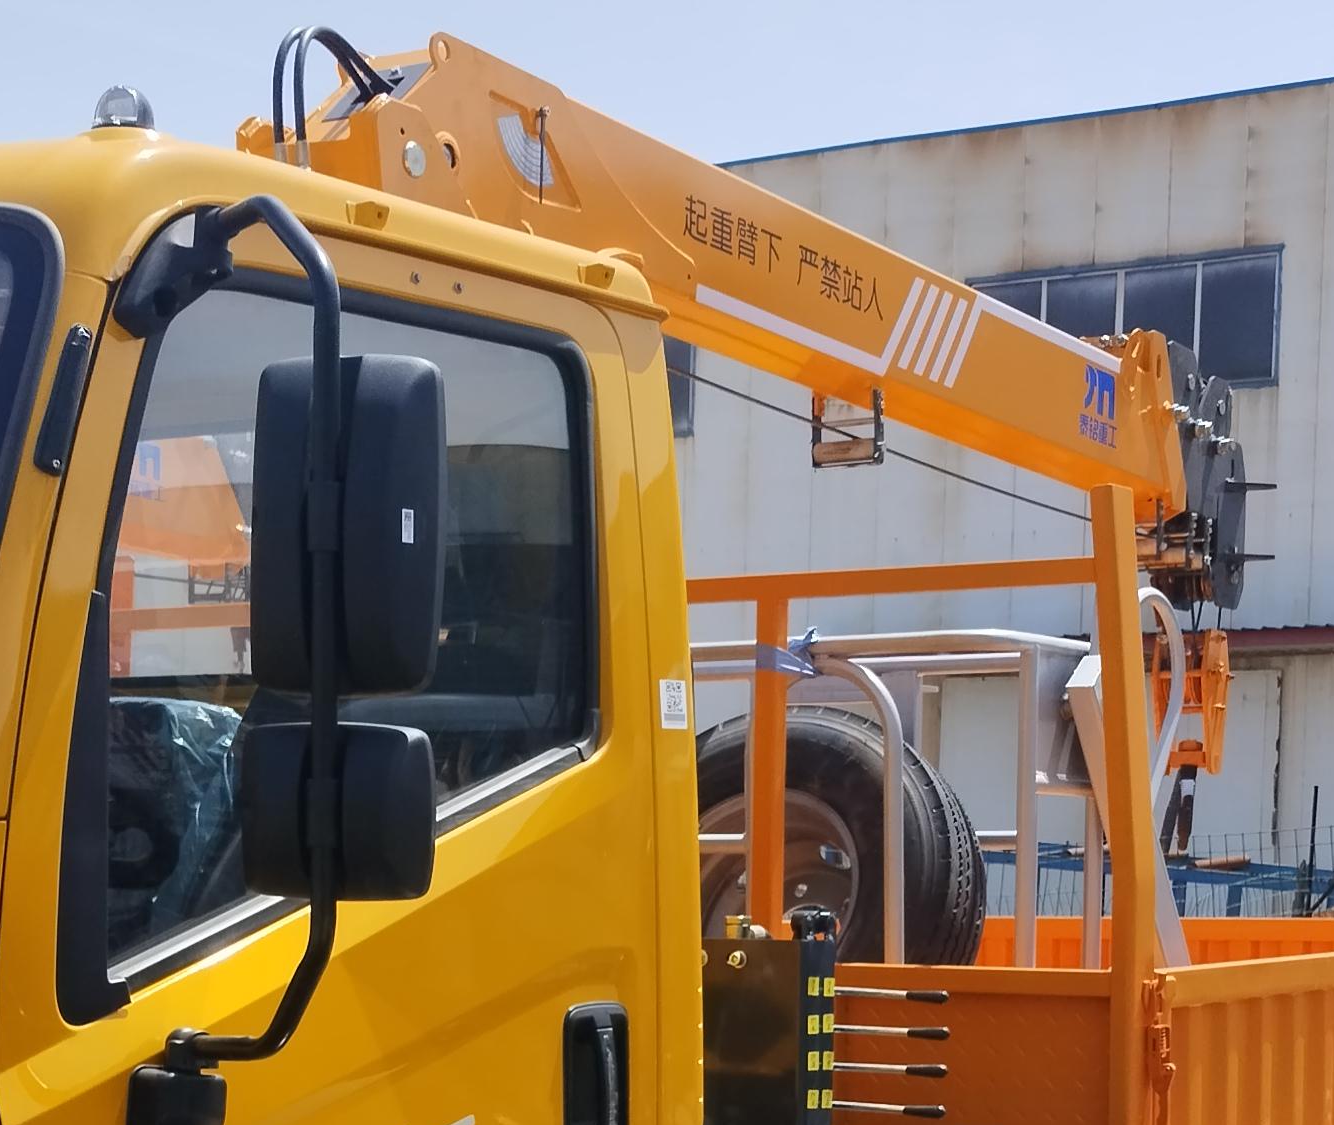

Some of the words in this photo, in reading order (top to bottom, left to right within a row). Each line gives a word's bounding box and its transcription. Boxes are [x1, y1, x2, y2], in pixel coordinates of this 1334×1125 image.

[683, 195, 782, 273] 起重臂下
[797, 244, 884, 321] 严禁站人
